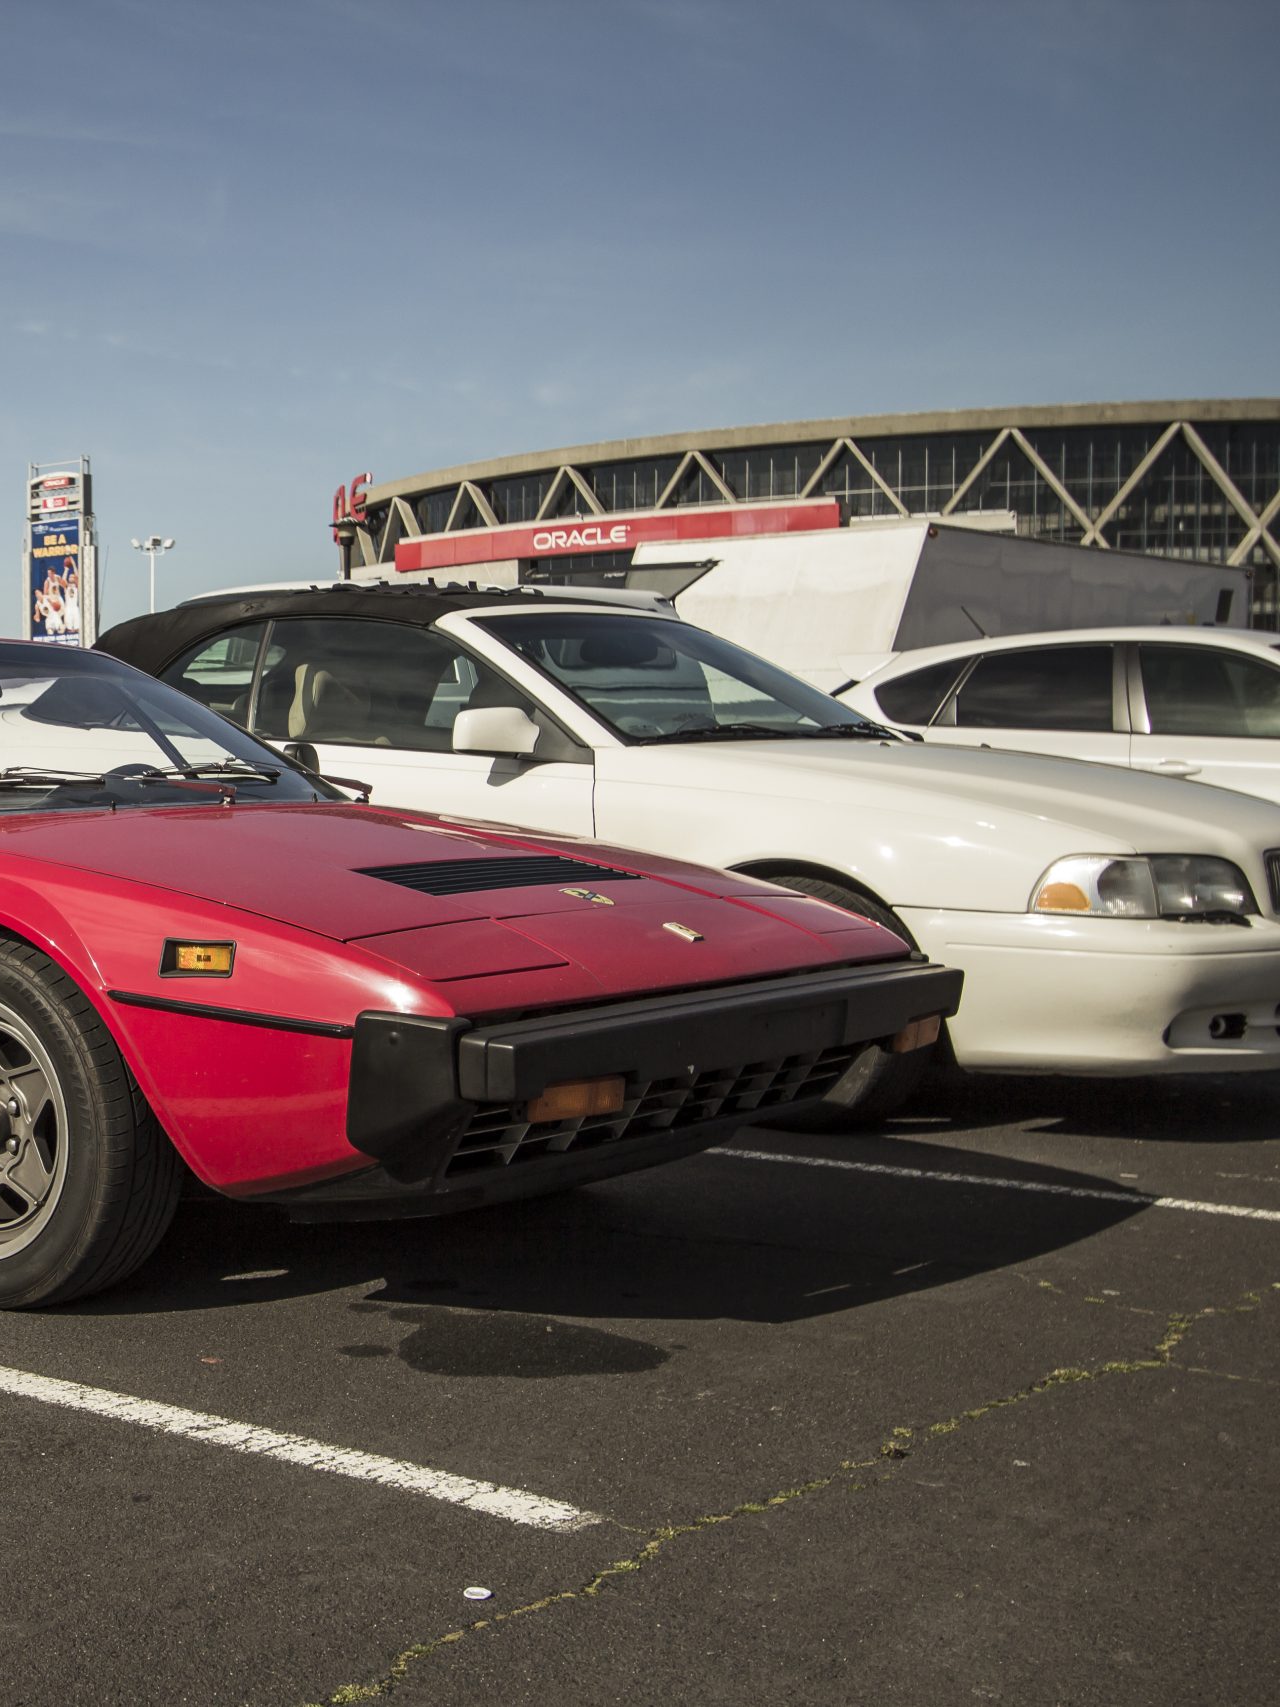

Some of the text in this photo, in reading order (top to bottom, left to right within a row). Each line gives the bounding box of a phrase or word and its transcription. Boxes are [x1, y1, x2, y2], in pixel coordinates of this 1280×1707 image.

[44, 534, 66, 546] BE A
[533, 525, 627, 550] ORACLE
[33, 544, 78, 558] WARRIOR
